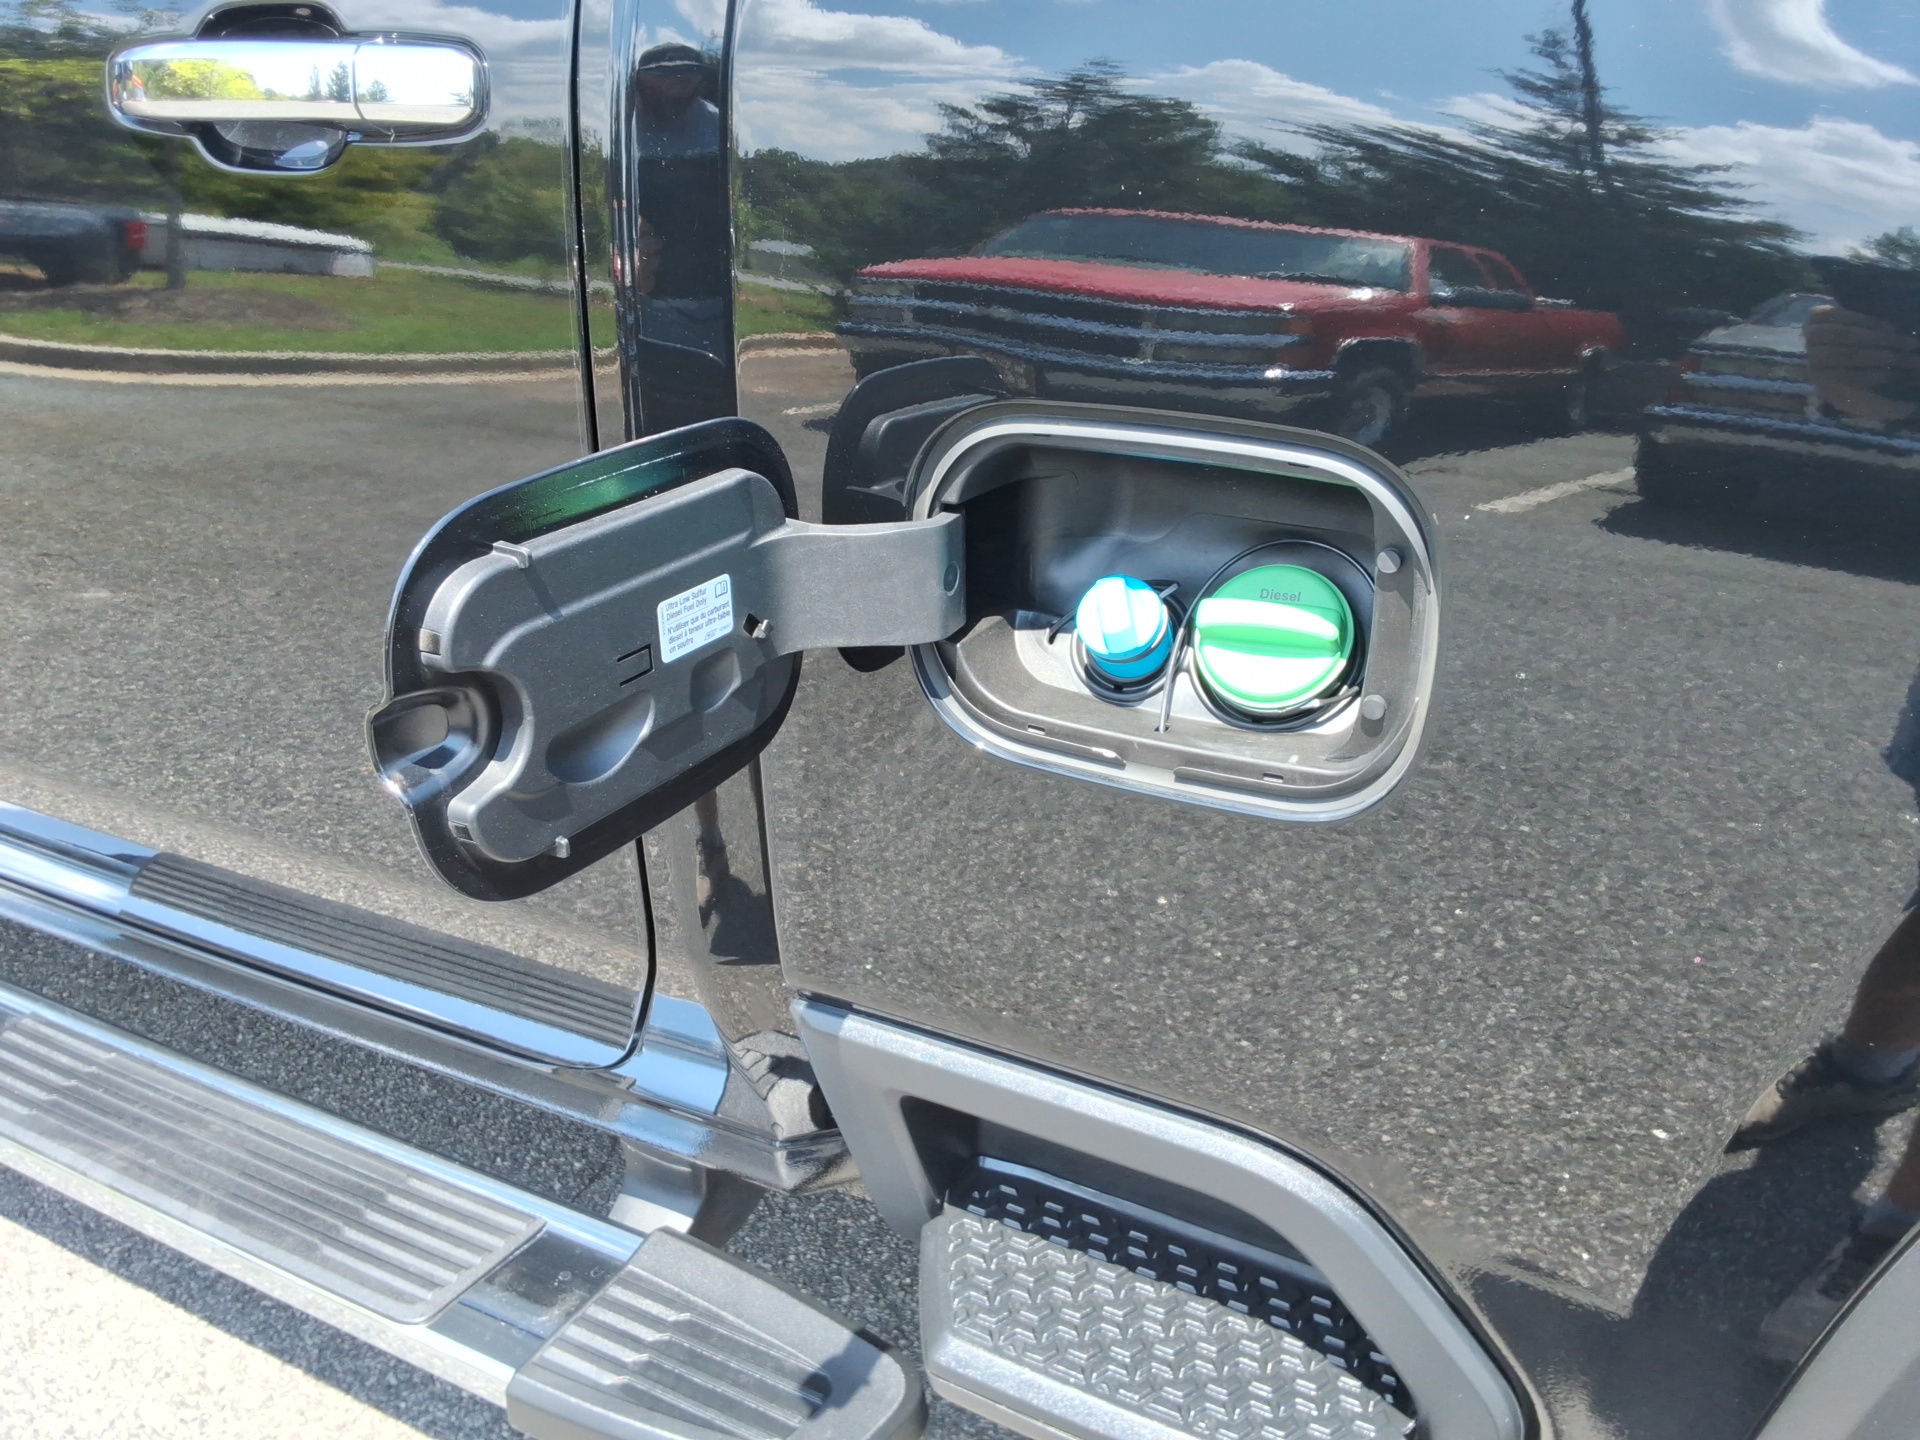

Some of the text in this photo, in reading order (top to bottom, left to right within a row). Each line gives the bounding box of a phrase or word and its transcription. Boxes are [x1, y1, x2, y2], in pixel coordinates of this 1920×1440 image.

[665, 588, 707, 612] Ultra Low Sulfur
[1260, 588, 1301, 602] Diesel
[666, 597, 707, 621] Diesel Fuel Only
[690, 615, 699, 625] que
[700, 612, 707, 620] du
[707, 600, 730, 615] carburant
[669, 637, 694, 654] en soufre
